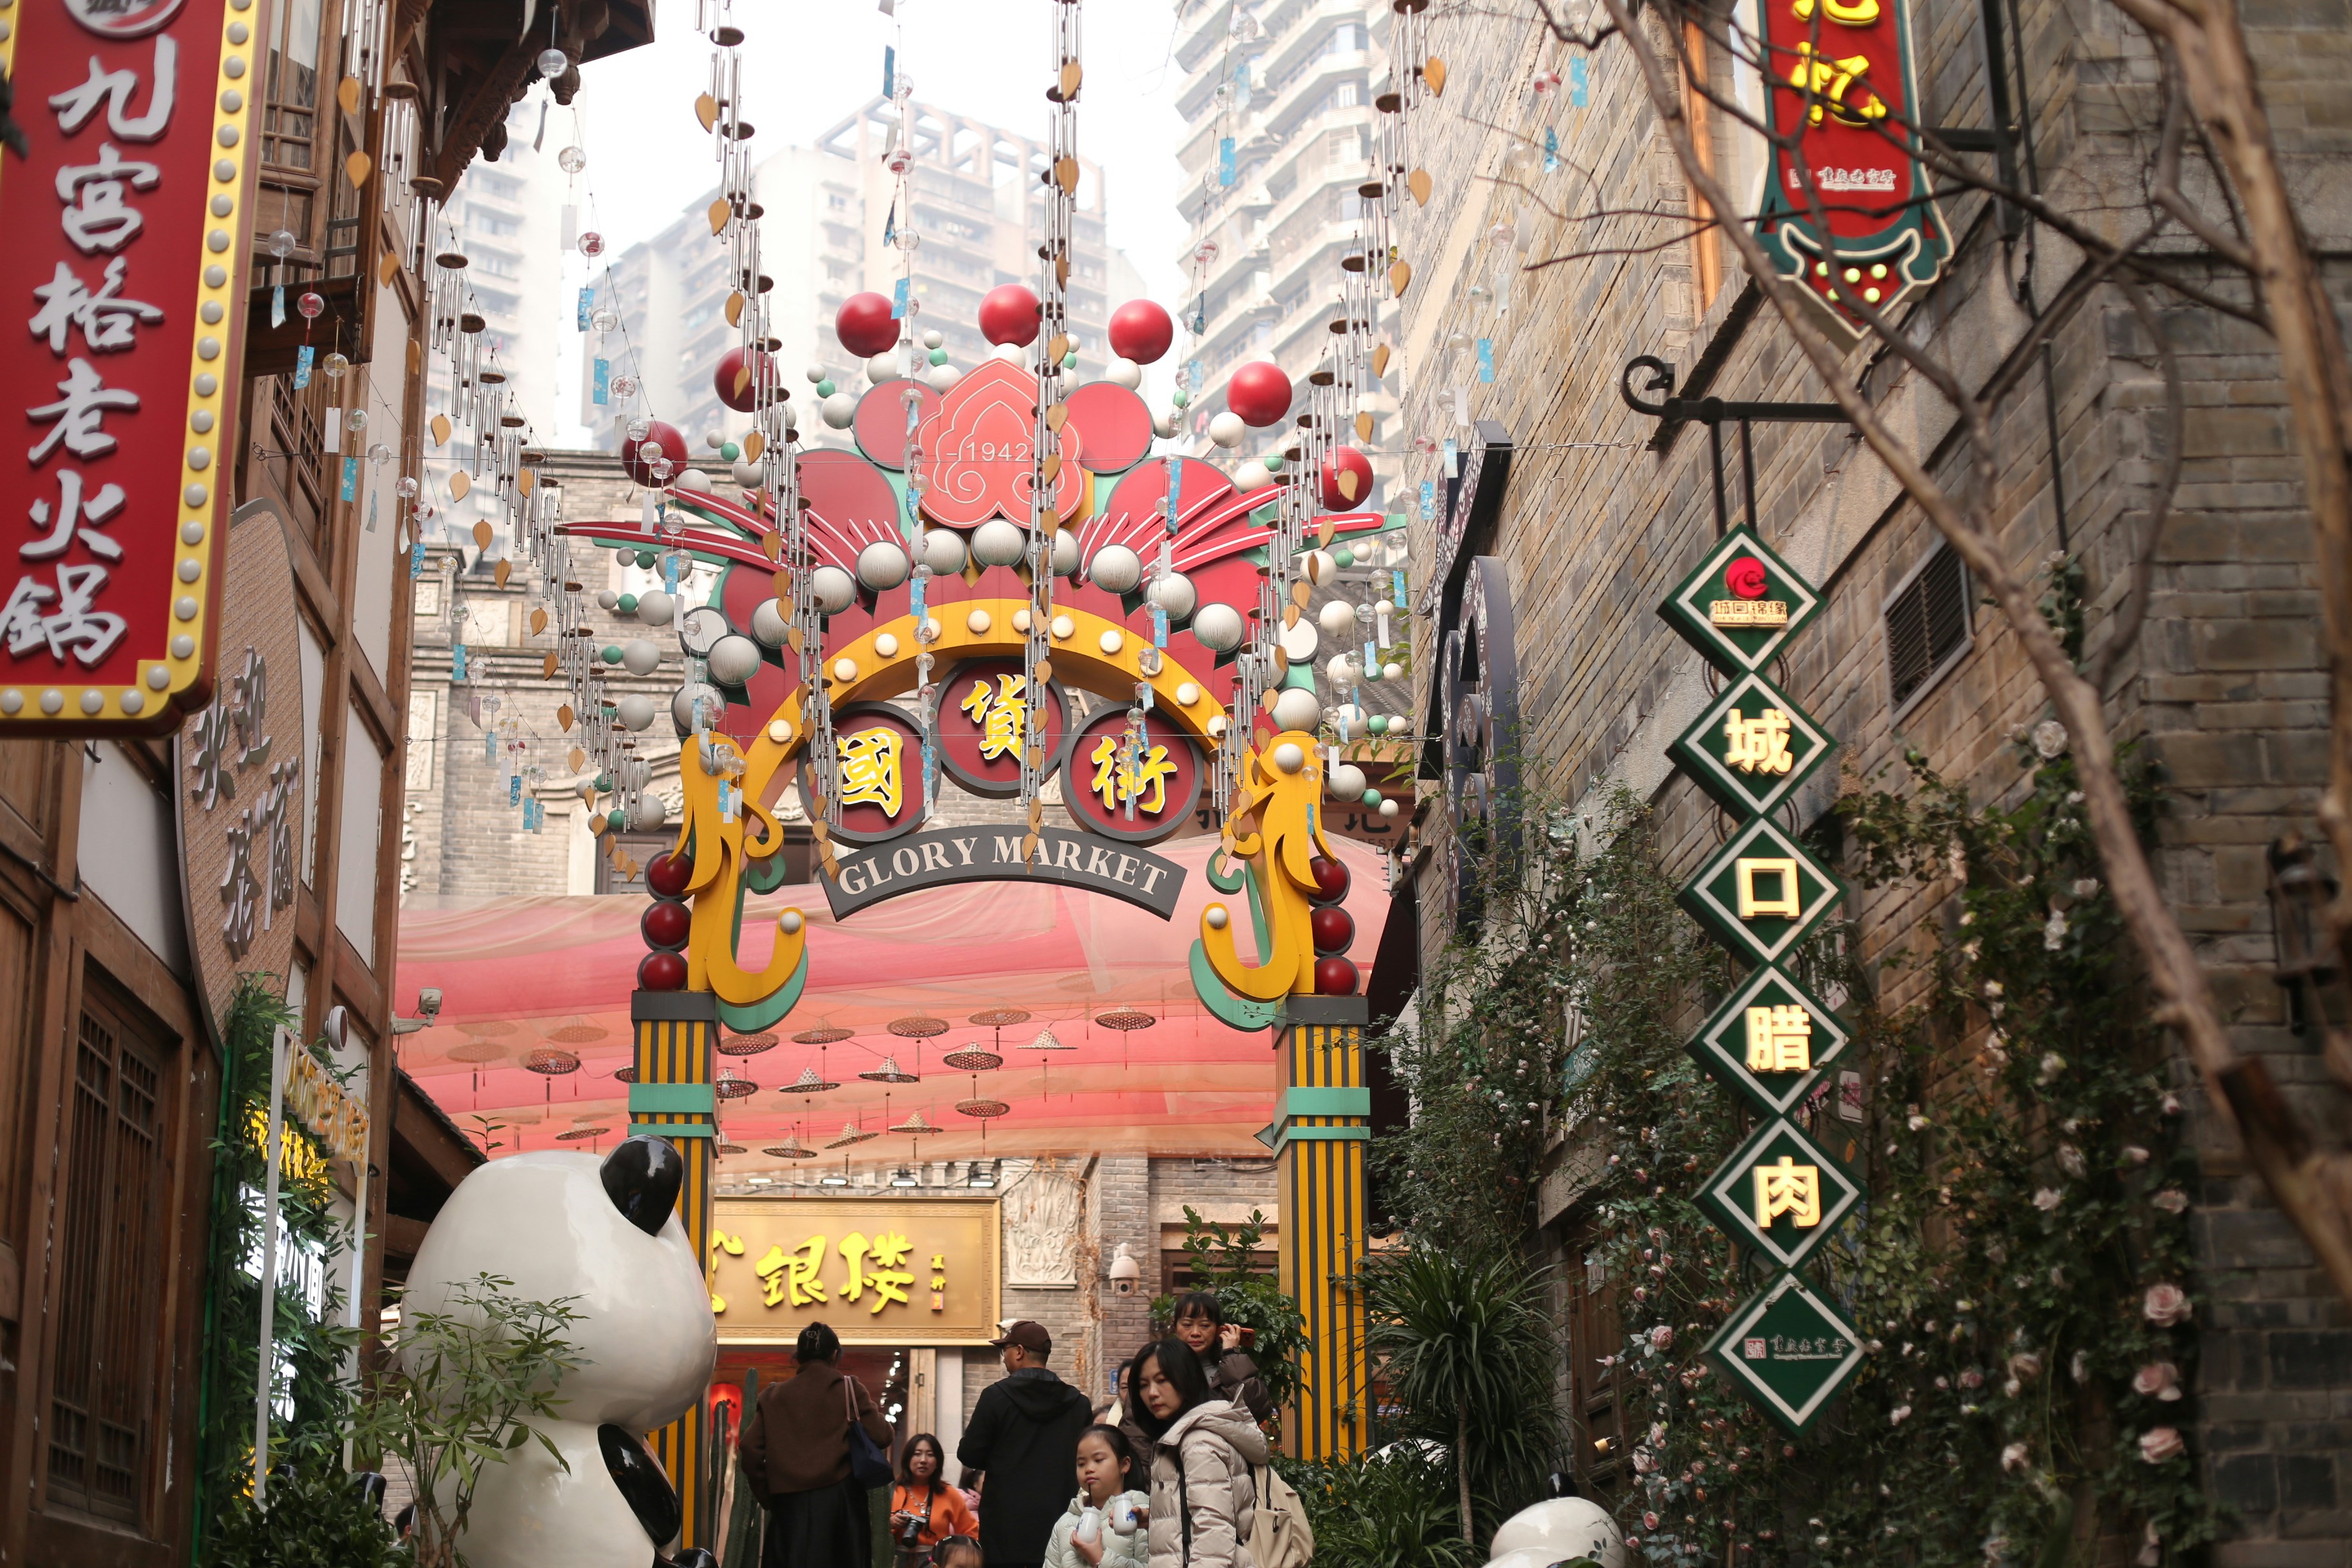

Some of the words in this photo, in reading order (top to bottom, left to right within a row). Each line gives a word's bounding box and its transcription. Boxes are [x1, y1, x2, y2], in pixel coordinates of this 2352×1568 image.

[1790, 0, 1886, 126] 忆
[838, 837, 978, 895] GLORY
[992, 836, 1168, 896] MARKET
[1725, 709, 1822, 1230] 城口腊肉
